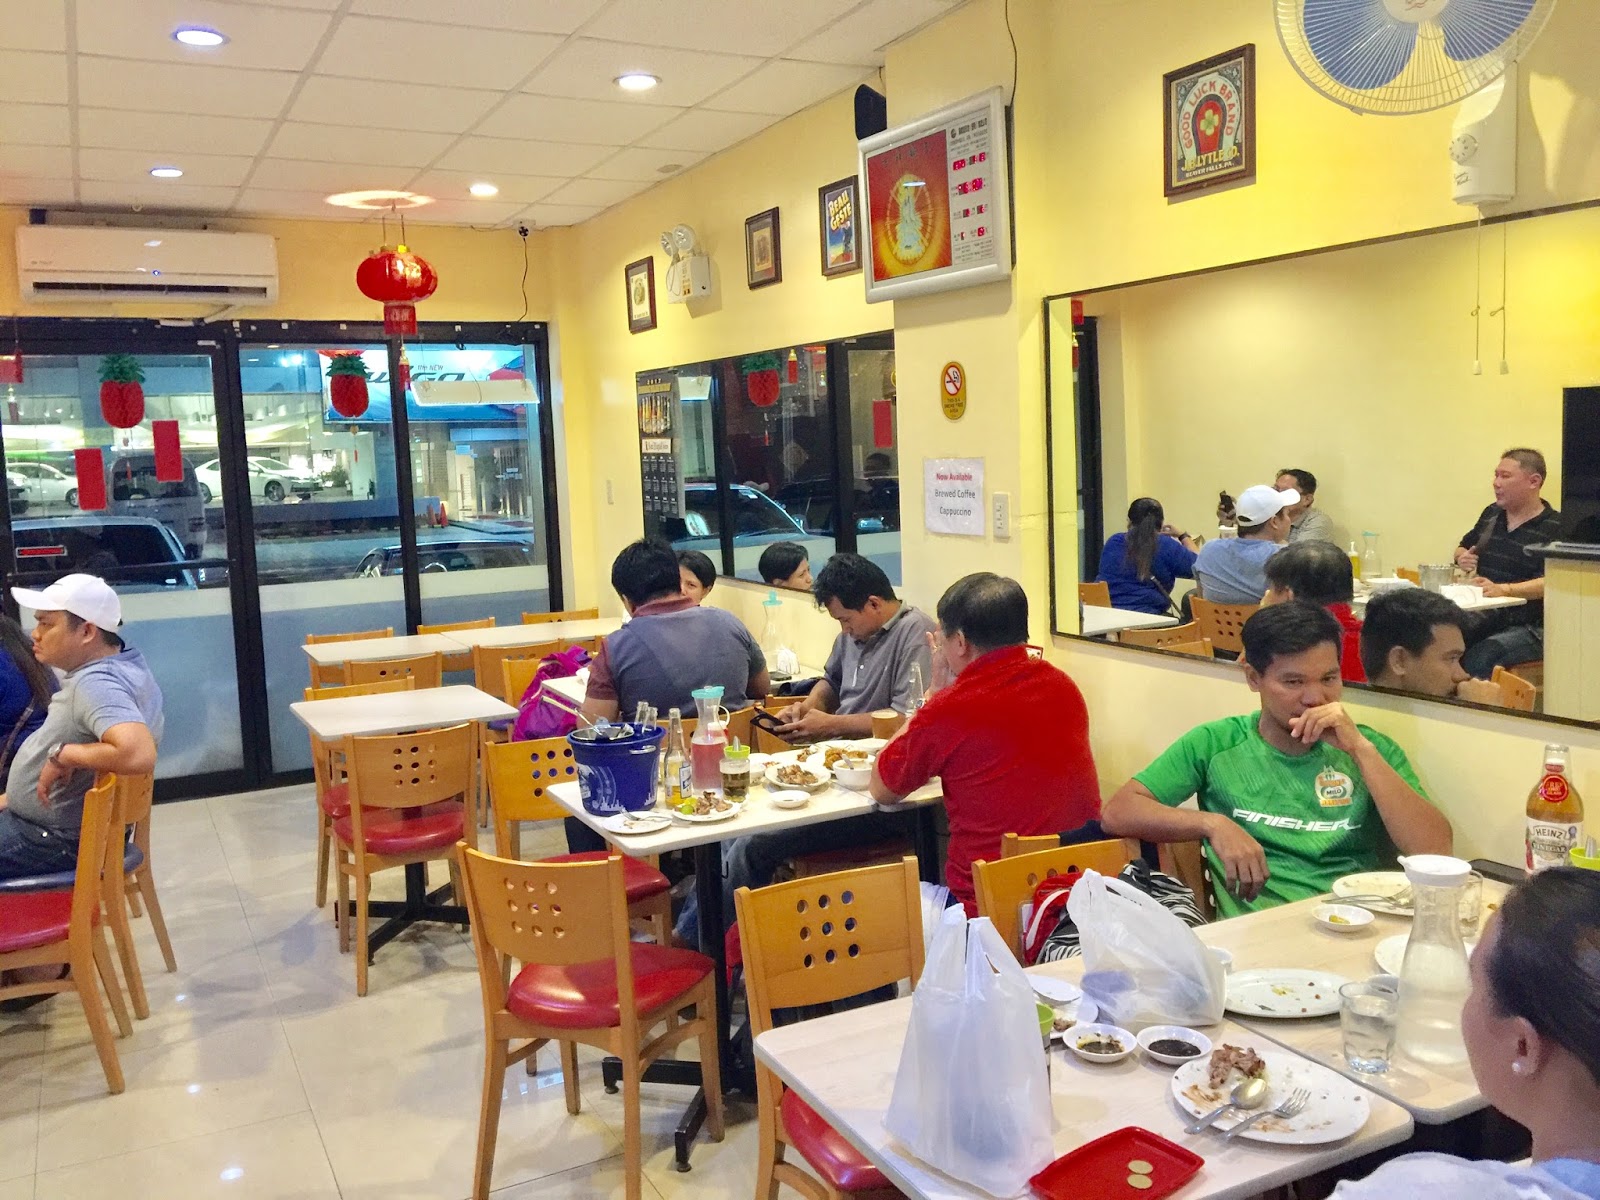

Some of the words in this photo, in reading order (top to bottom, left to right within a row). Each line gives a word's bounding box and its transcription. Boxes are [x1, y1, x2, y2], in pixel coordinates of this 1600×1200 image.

[1182, 111, 1193, 149] GOOD
[1189, 80, 1216, 107] LUCK
[1219, 83, 1236, 136] BRAND
[828, 189, 850, 218] BEAU
[830, 202, 852, 231] GESTE
[949, 472, 973, 481] Available
[934, 489, 956, 498] Brewed
[957, 489, 976, 499] Coffee
[939, 506, 972, 517] Cappuccino
[1326, 788, 1342, 796] MILO
[1232, 808, 1361, 831] FINISHER
[1535, 828, 1563, 839] HEINZ
